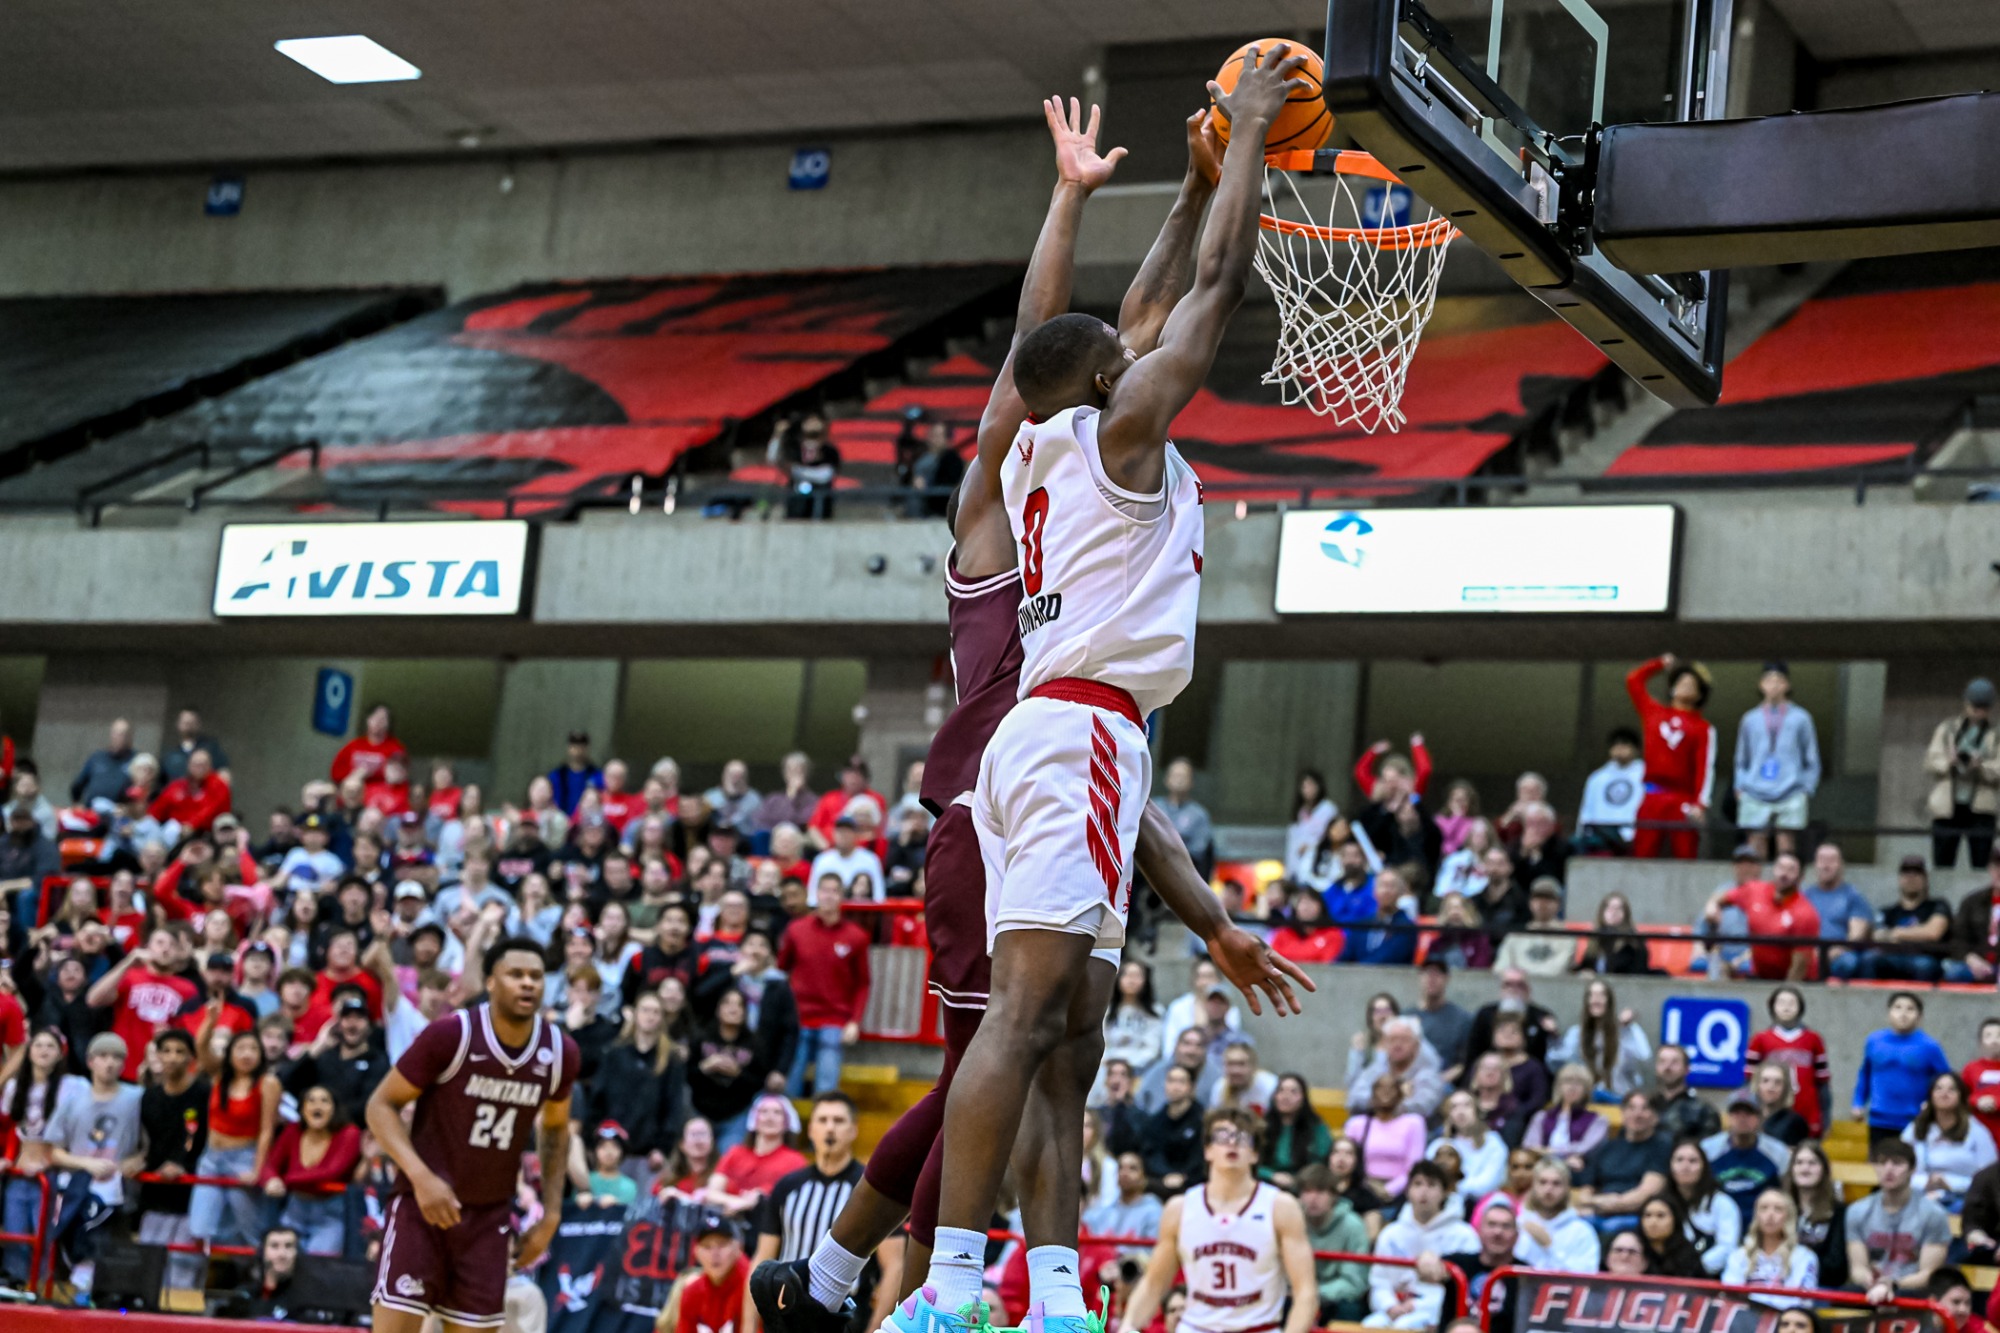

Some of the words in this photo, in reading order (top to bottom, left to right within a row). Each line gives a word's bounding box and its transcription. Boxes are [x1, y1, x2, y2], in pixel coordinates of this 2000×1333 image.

[1021, 486, 1050, 598] 0
[464, 1073, 543, 1107] MONTANA
[468, 1103, 519, 1151] 24
[1211, 1261, 1237, 1290] 31
[1529, 1282, 1752, 1333] FLIGHT
